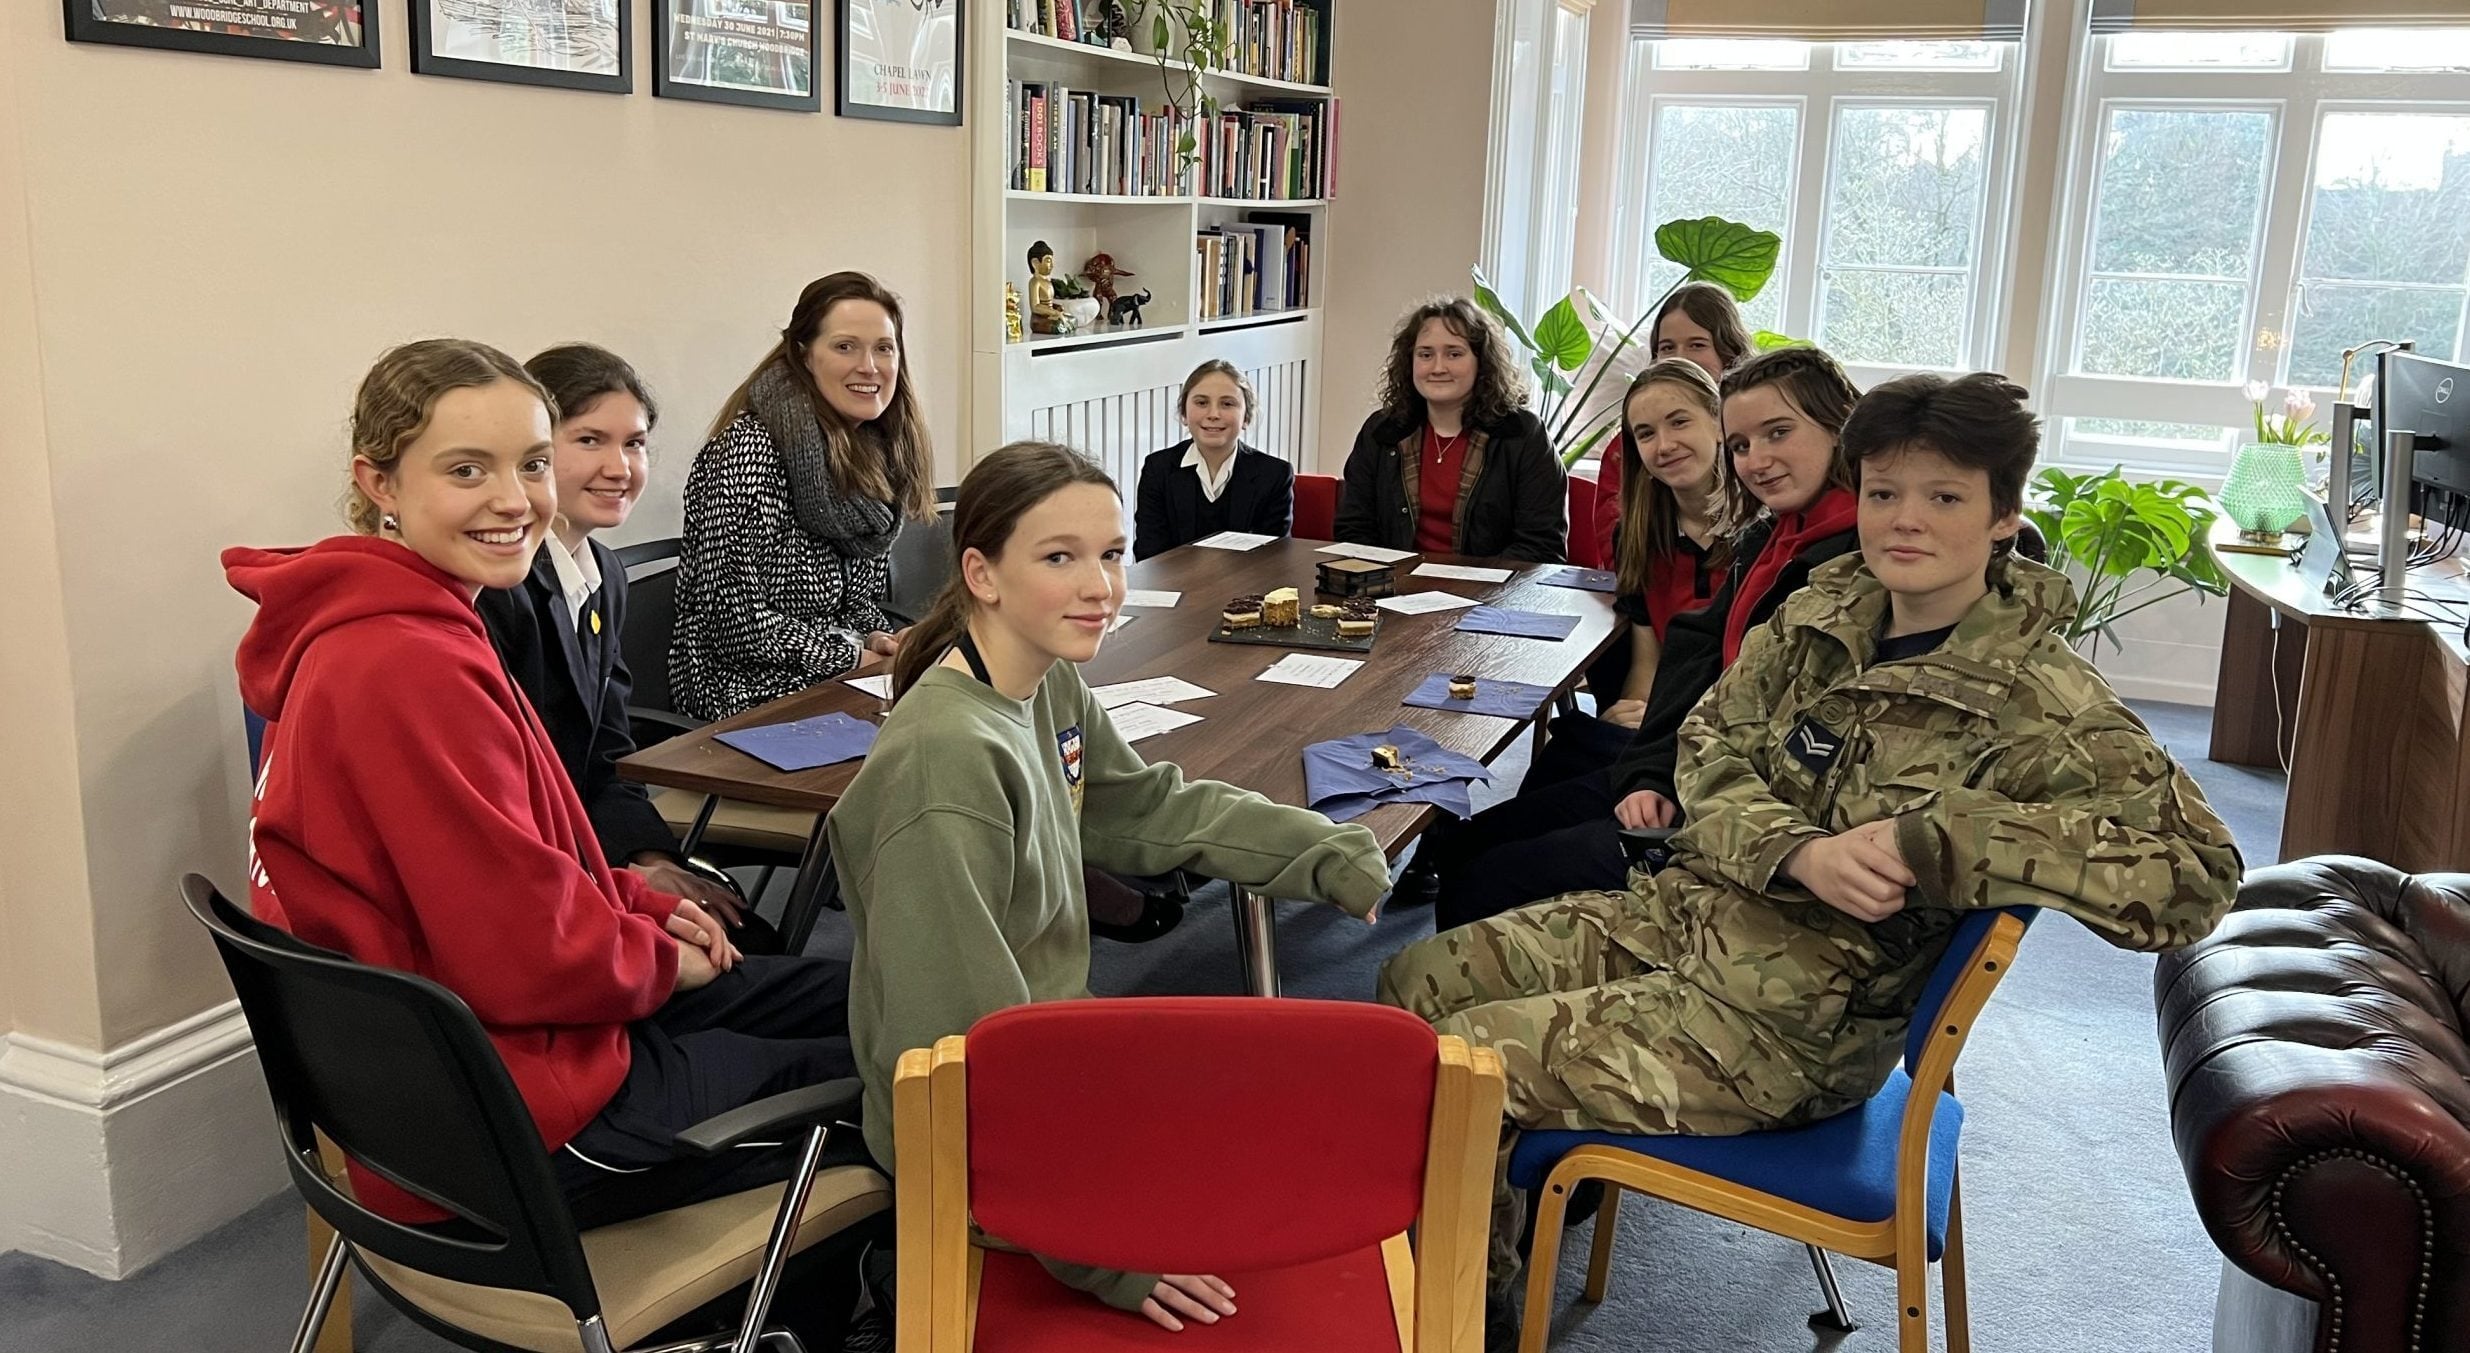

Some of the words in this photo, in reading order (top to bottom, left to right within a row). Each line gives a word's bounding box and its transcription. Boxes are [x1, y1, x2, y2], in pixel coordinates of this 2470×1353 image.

[169, 4, 297, 29] WWW.WOODBRIDGESCHOOL.ORG.UK
[674, 12, 722, 29] WEDNESDAY
[724, 20, 734, 31] 30
[735, 21, 756, 34] JUNE
[779, 29, 805, 42] 7:30PM
[684, 31, 695, 40] ST
[874, 64, 906, 78] CHAPEL
[908, 68, 932, 80] LAWN
